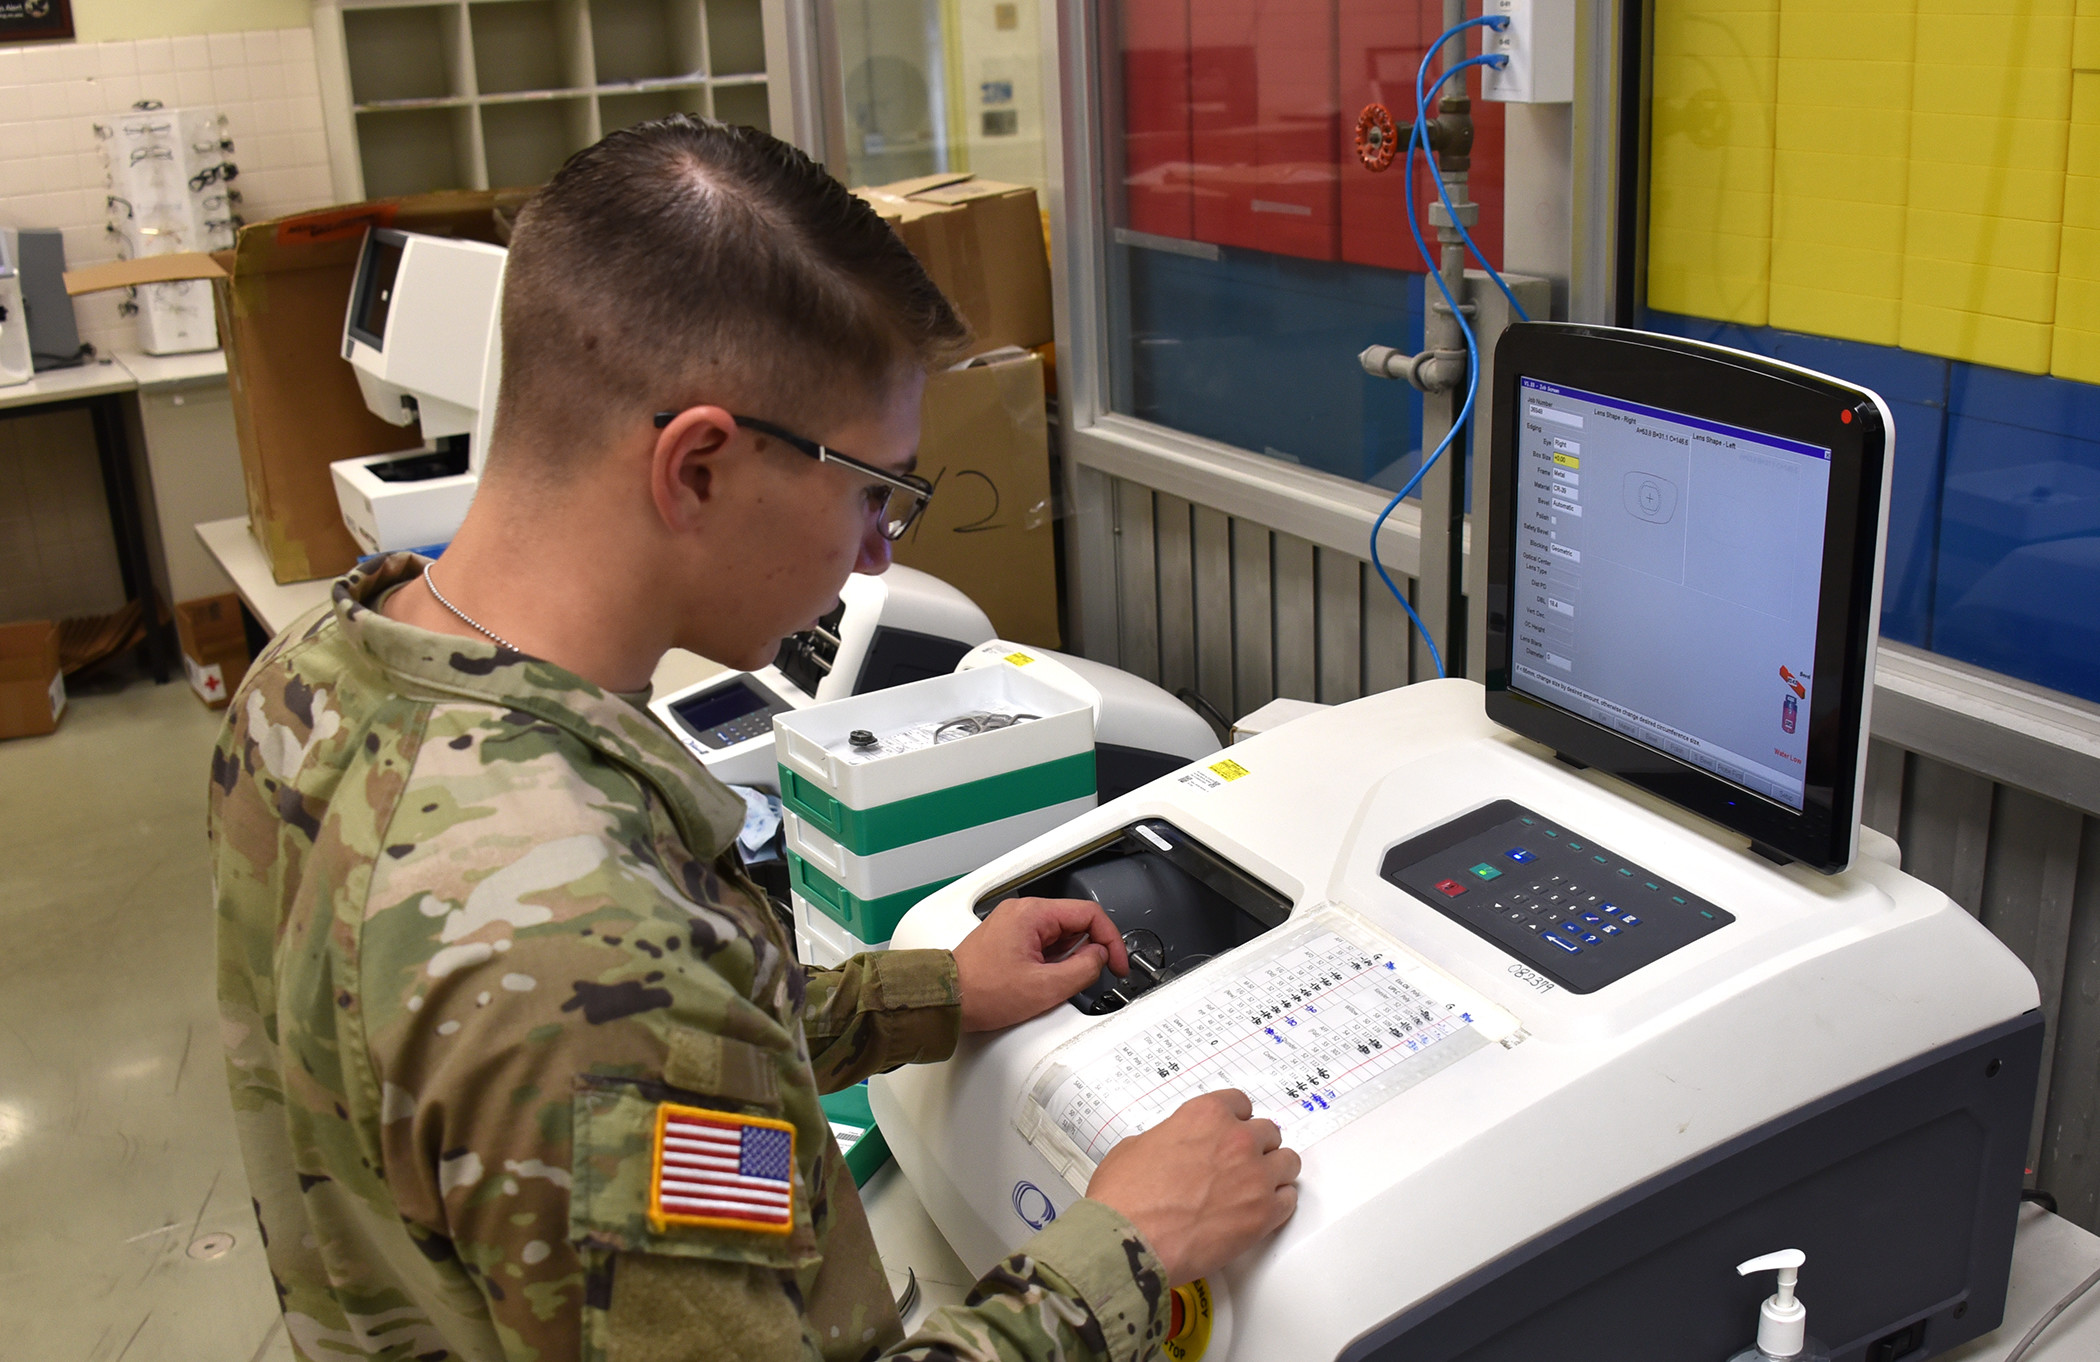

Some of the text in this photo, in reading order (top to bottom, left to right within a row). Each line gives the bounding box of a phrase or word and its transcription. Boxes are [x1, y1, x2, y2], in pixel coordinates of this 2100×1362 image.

[1535, 398, 1552, 407] Number
[1594, 408, 1636, 425] Lens Shape Right
[1526, 422, 1541, 432] Edging
[1555, 439, 1566, 448] Right
[1692, 433, 1735, 449] Lens Shape Left
[1537, 466, 1550, 475] Frame
[1553, 500, 1573, 511] Automatic
[1551, 544, 1572, 556] Geometric
[1523, 551, 1550, 566] Optical Center
[1526, 563, 1536, 571] Lens
[1536, 673, 1550, 684] change
[1560, 683, 1565, 691] by
[1567, 686, 1582, 697] desired
[1600, 699, 1621, 713] otherwise
[1622, 708, 1638, 721] change
[1639, 715, 1655, 727] desired
[1656, 722, 1688, 741] circumference
[1774, 747, 1801, 764] Water Low
[1507, 963, 1554, 994] 082379
